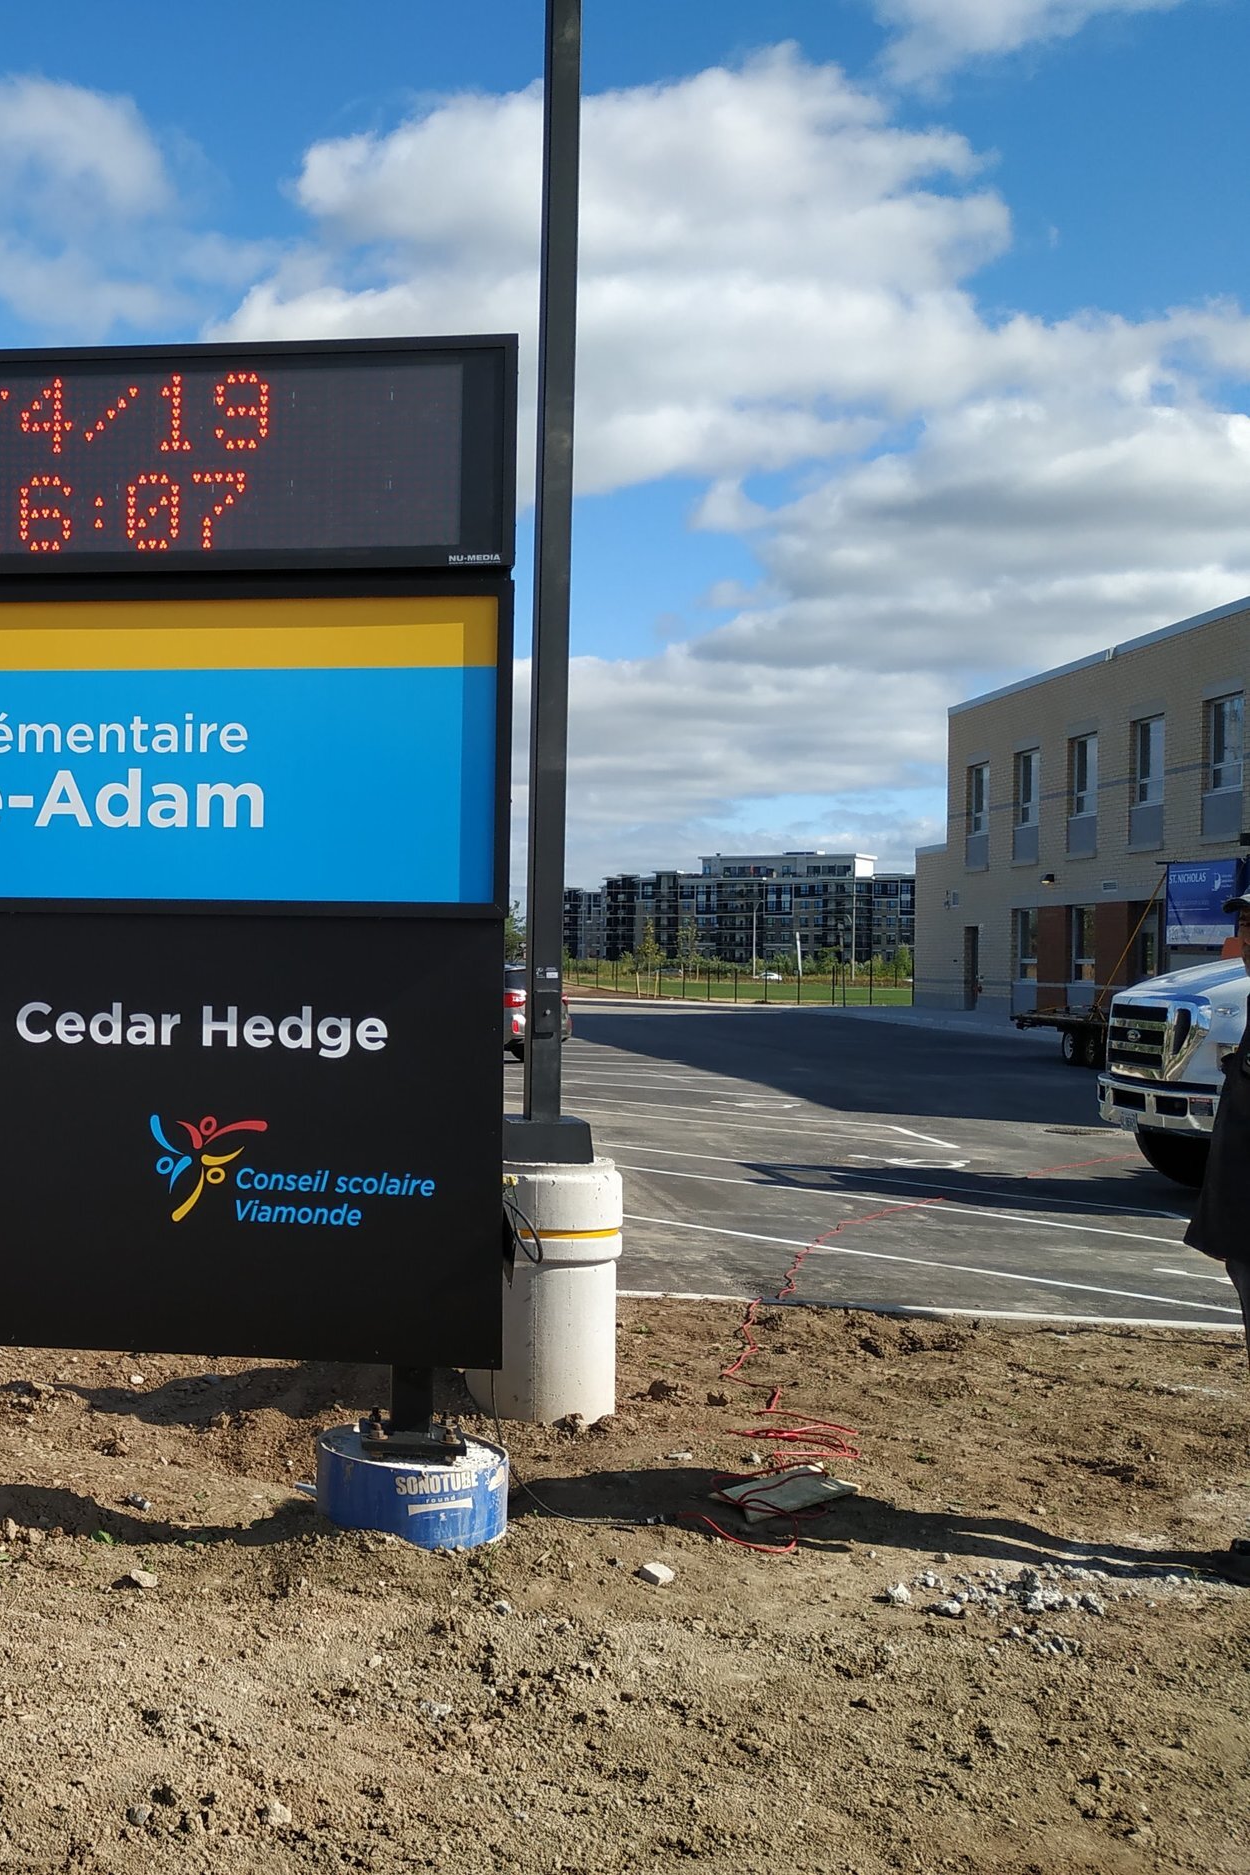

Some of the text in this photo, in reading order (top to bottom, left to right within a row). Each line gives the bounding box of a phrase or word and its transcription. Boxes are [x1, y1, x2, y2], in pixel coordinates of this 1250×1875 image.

[1178, 872, 1207, 883] NICHOLAS
[15, 1001, 181, 1046] Cedar
[202, 1005, 389, 1059] Hedge
[235, 1167, 436, 1197] Conseil scolaire
[234, 1199, 363, 1227] Viamonde
[395, 1470, 479, 1496] SONOTUBE
